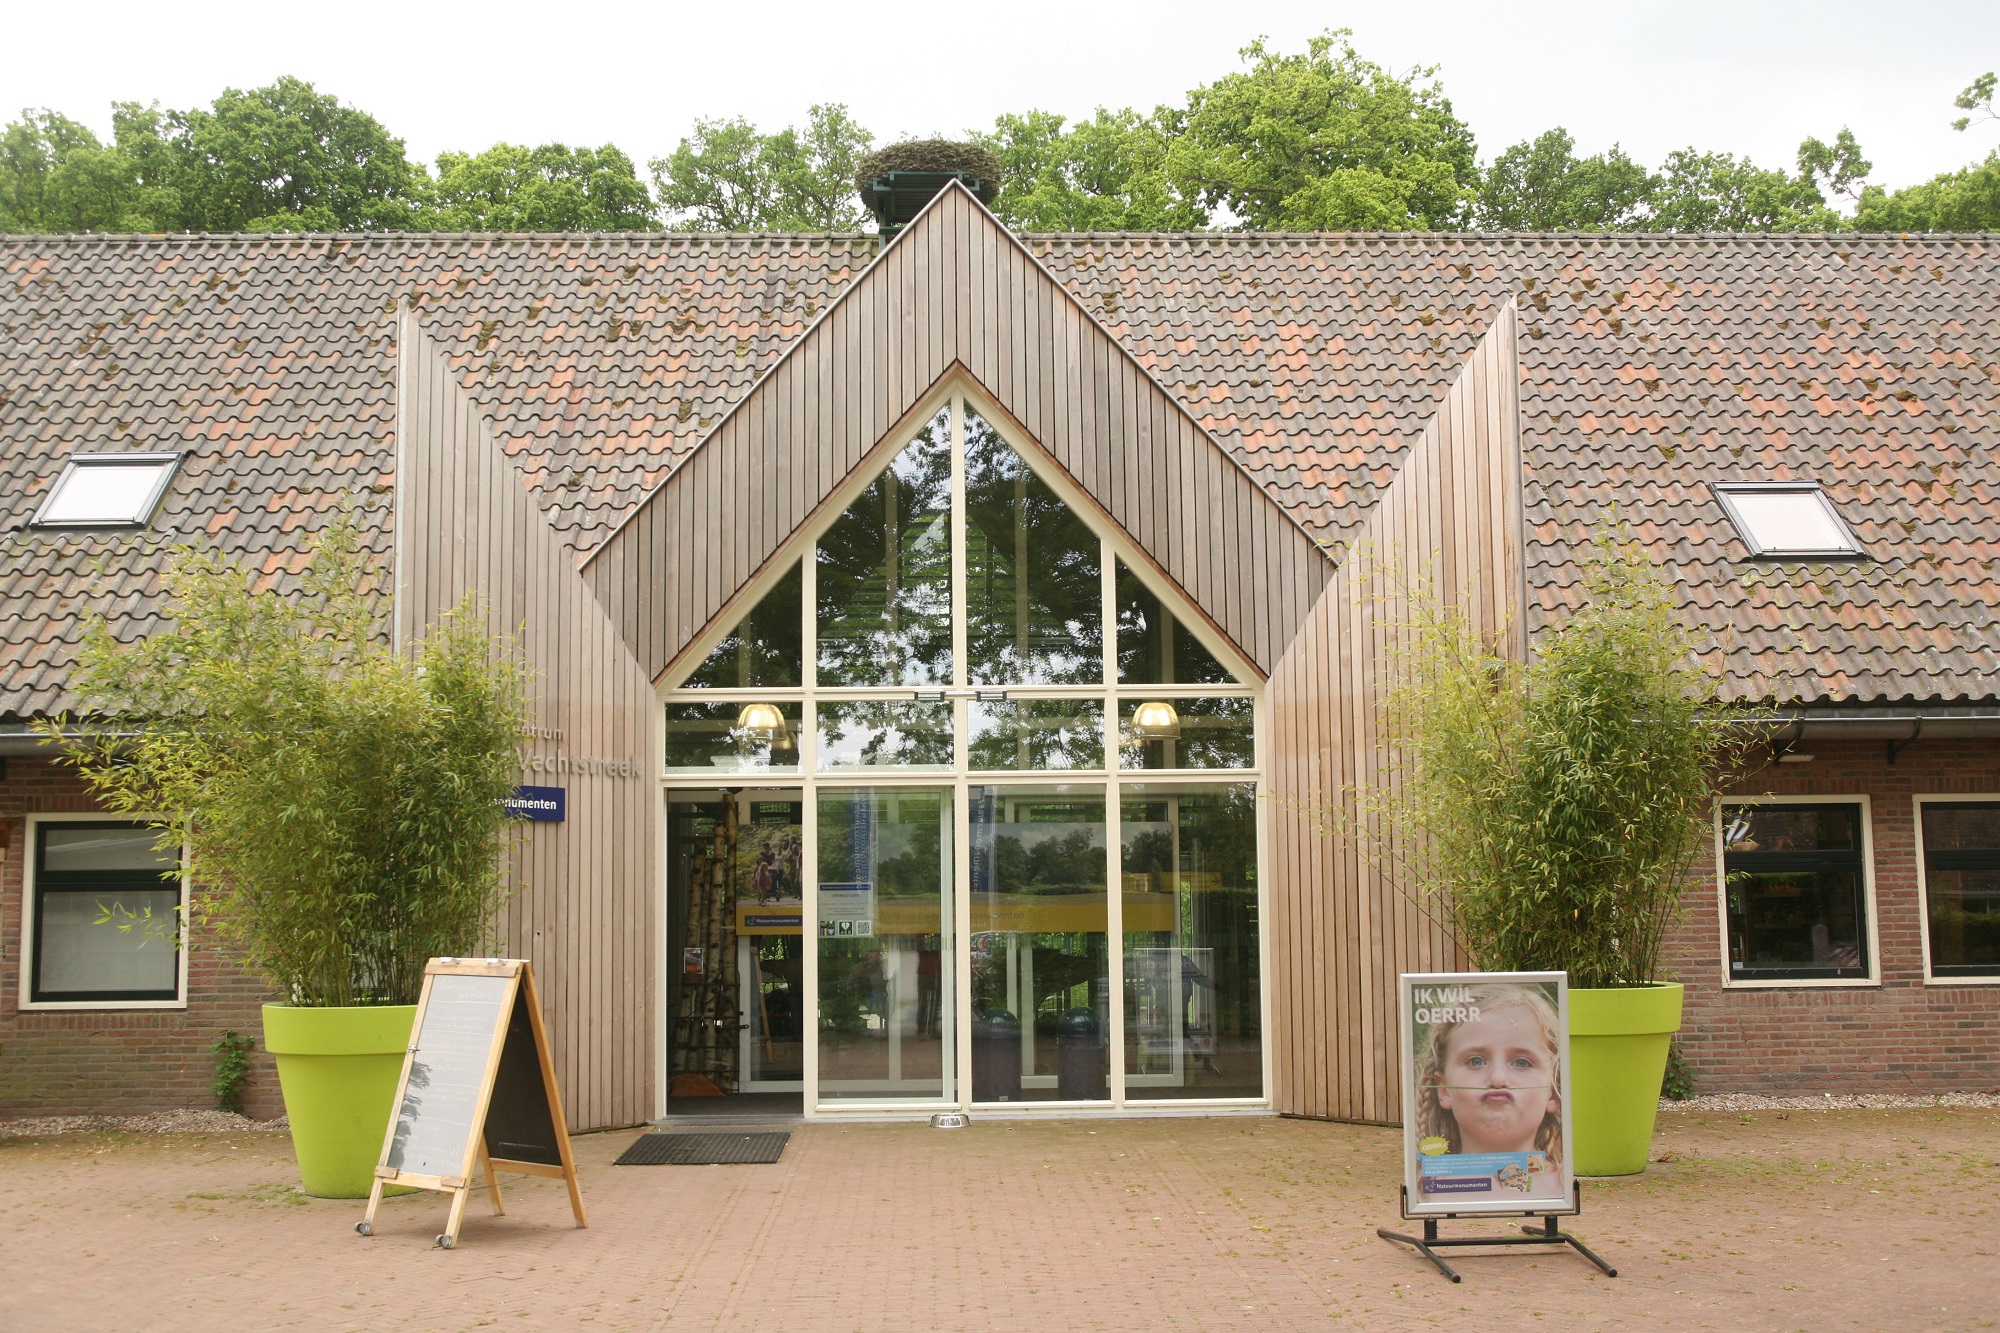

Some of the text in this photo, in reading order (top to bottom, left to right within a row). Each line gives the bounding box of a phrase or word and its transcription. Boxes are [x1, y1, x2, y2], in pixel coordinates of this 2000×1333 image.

[489, 798, 557, 810] numenten
[1414, 987, 1476, 1004] IK WIL
[1414, 1007, 1482, 1024] OERRR
[1436, 1181, 1488, 1190] Natuurmonumenten
